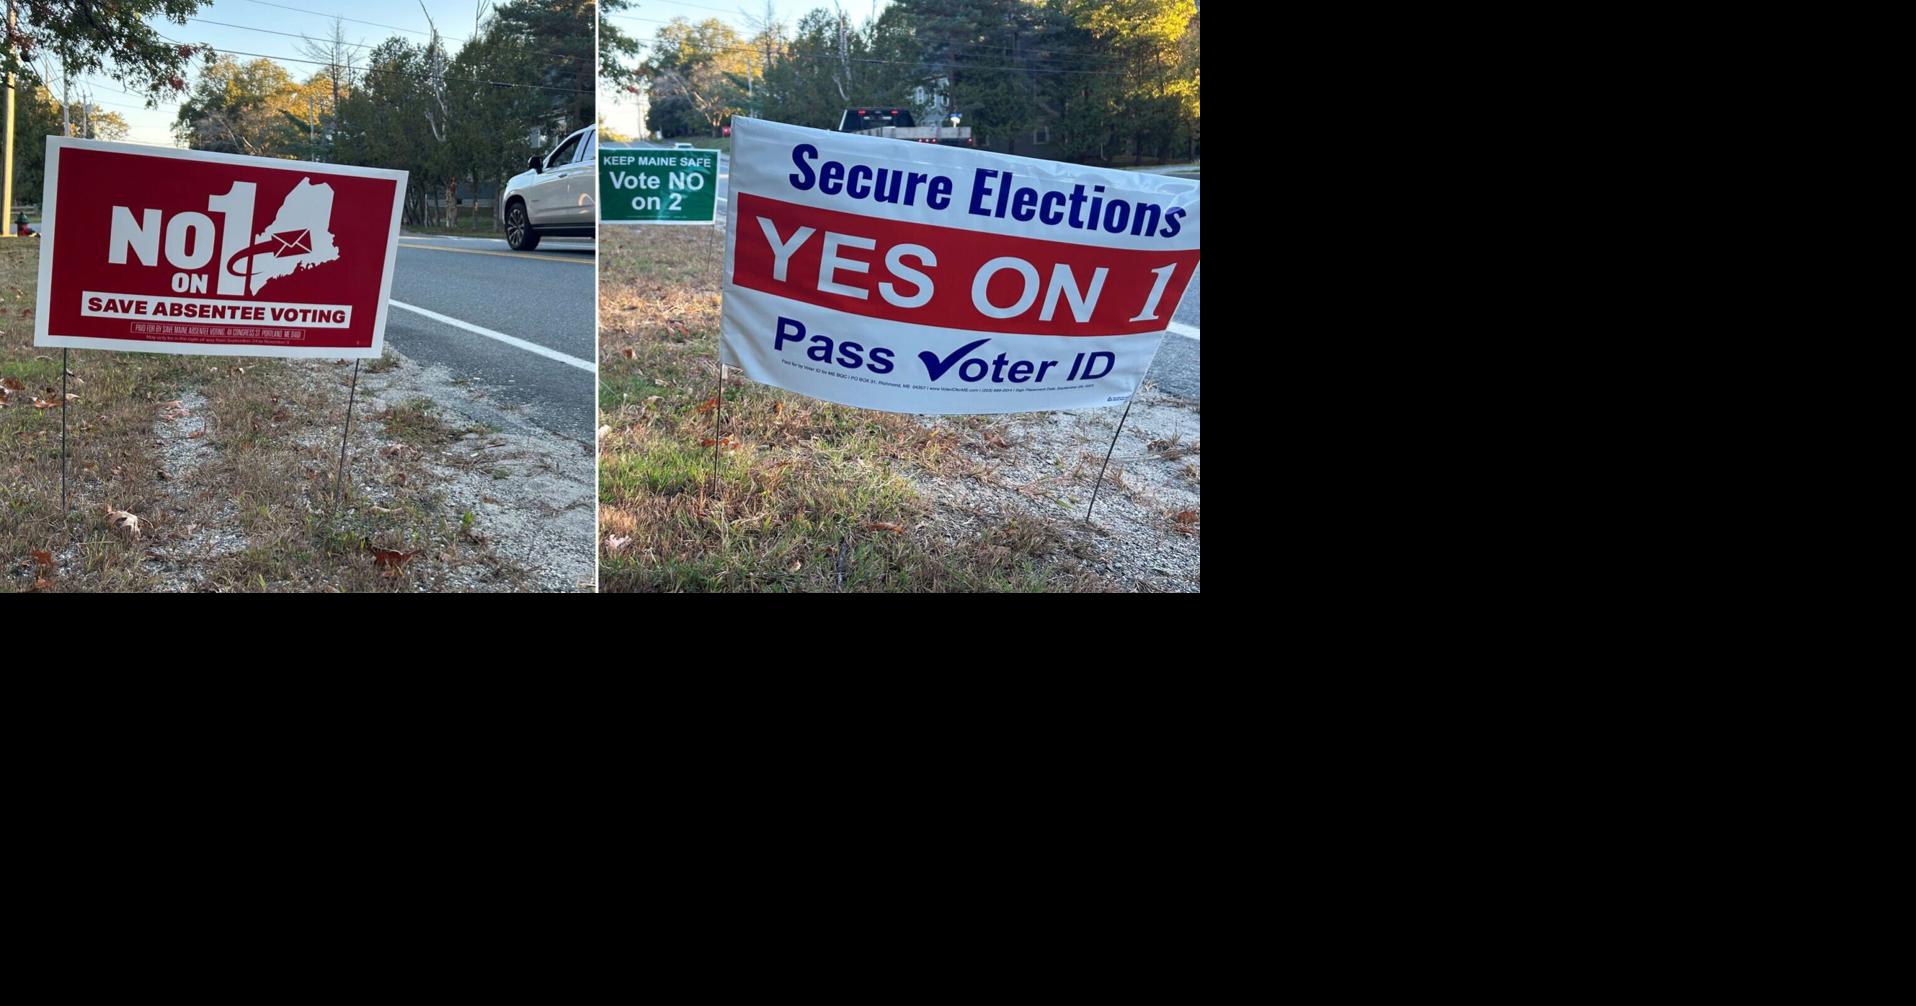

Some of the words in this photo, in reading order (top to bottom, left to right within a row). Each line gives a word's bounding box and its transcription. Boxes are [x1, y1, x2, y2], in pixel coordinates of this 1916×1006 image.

[603, 156, 636, 166] KEEP
[638, 157, 676, 166] MAINE
[680, 158, 711, 168] SAFE
[610, 171, 661, 190] Vote
[669, 172, 705, 191] NO
[632, 196, 661, 211] on
[668, 192, 683, 211] 2
[789, 143, 953, 211] Secure
[969, 167, 1187, 240] Elections
[109, 206, 216, 270] NO
[171, 273, 209, 294] ON
[207, 180, 257, 297] 1
[756, 216, 938, 309] YES
[971, 256, 1109, 323] ON
[1129, 262, 1177, 323] 1
[87, 297, 148, 316] SAVE
[152, 301, 265, 322] ABSENTEE
[270, 307, 346, 324] VOTING
[774, 316, 896, 374] Pass
[1066, 351, 1116, 382] ID
